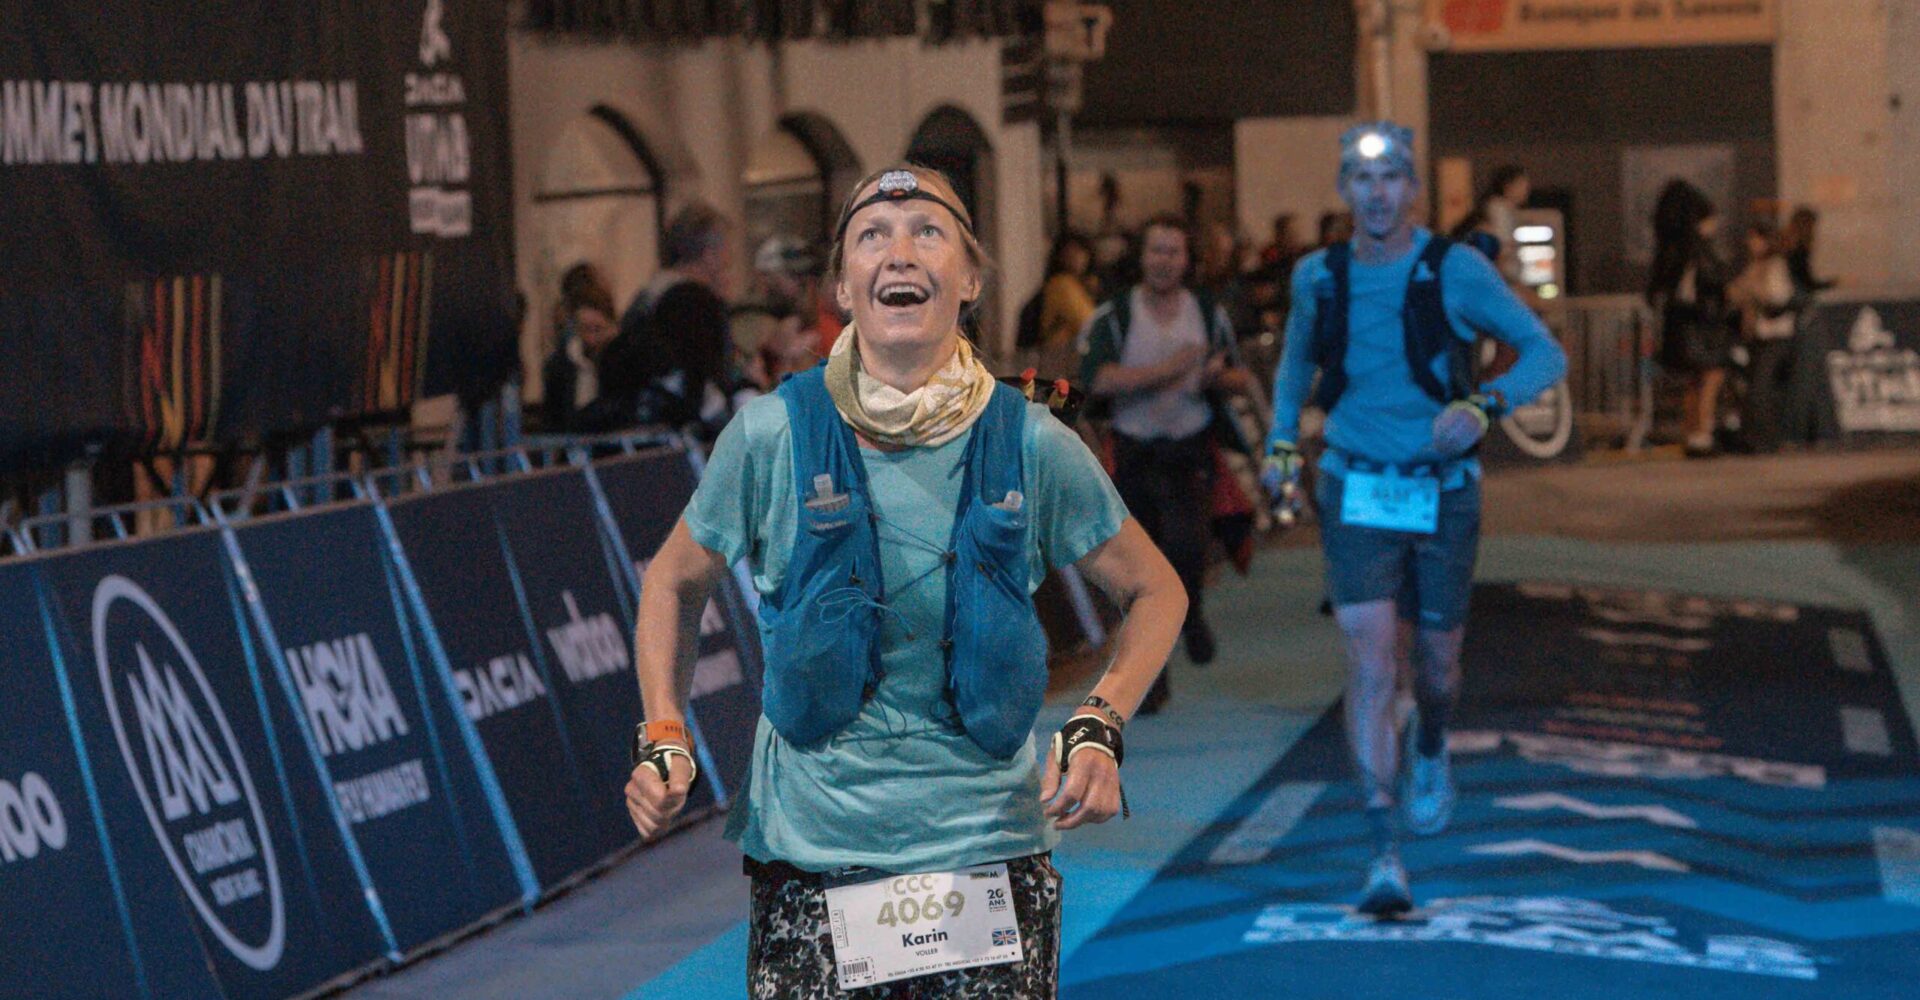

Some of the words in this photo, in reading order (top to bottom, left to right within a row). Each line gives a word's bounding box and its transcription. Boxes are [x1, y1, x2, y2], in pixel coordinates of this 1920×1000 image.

[99, 80, 244, 163] MONDIAL
[244, 80, 296, 158] DU
[293, 79, 363, 155] TRAIL
[285, 632, 408, 756] HOKA
[453, 654, 545, 720] DACIA
[893, 874, 933, 895] CCC
[987, 888, 1004, 899] 20
[877, 890, 965, 928] 4069
[988, 898, 1006, 907] ANS
[902, 928, 948, 947] Karin
[915, 947, 938, 957] VOLLER
